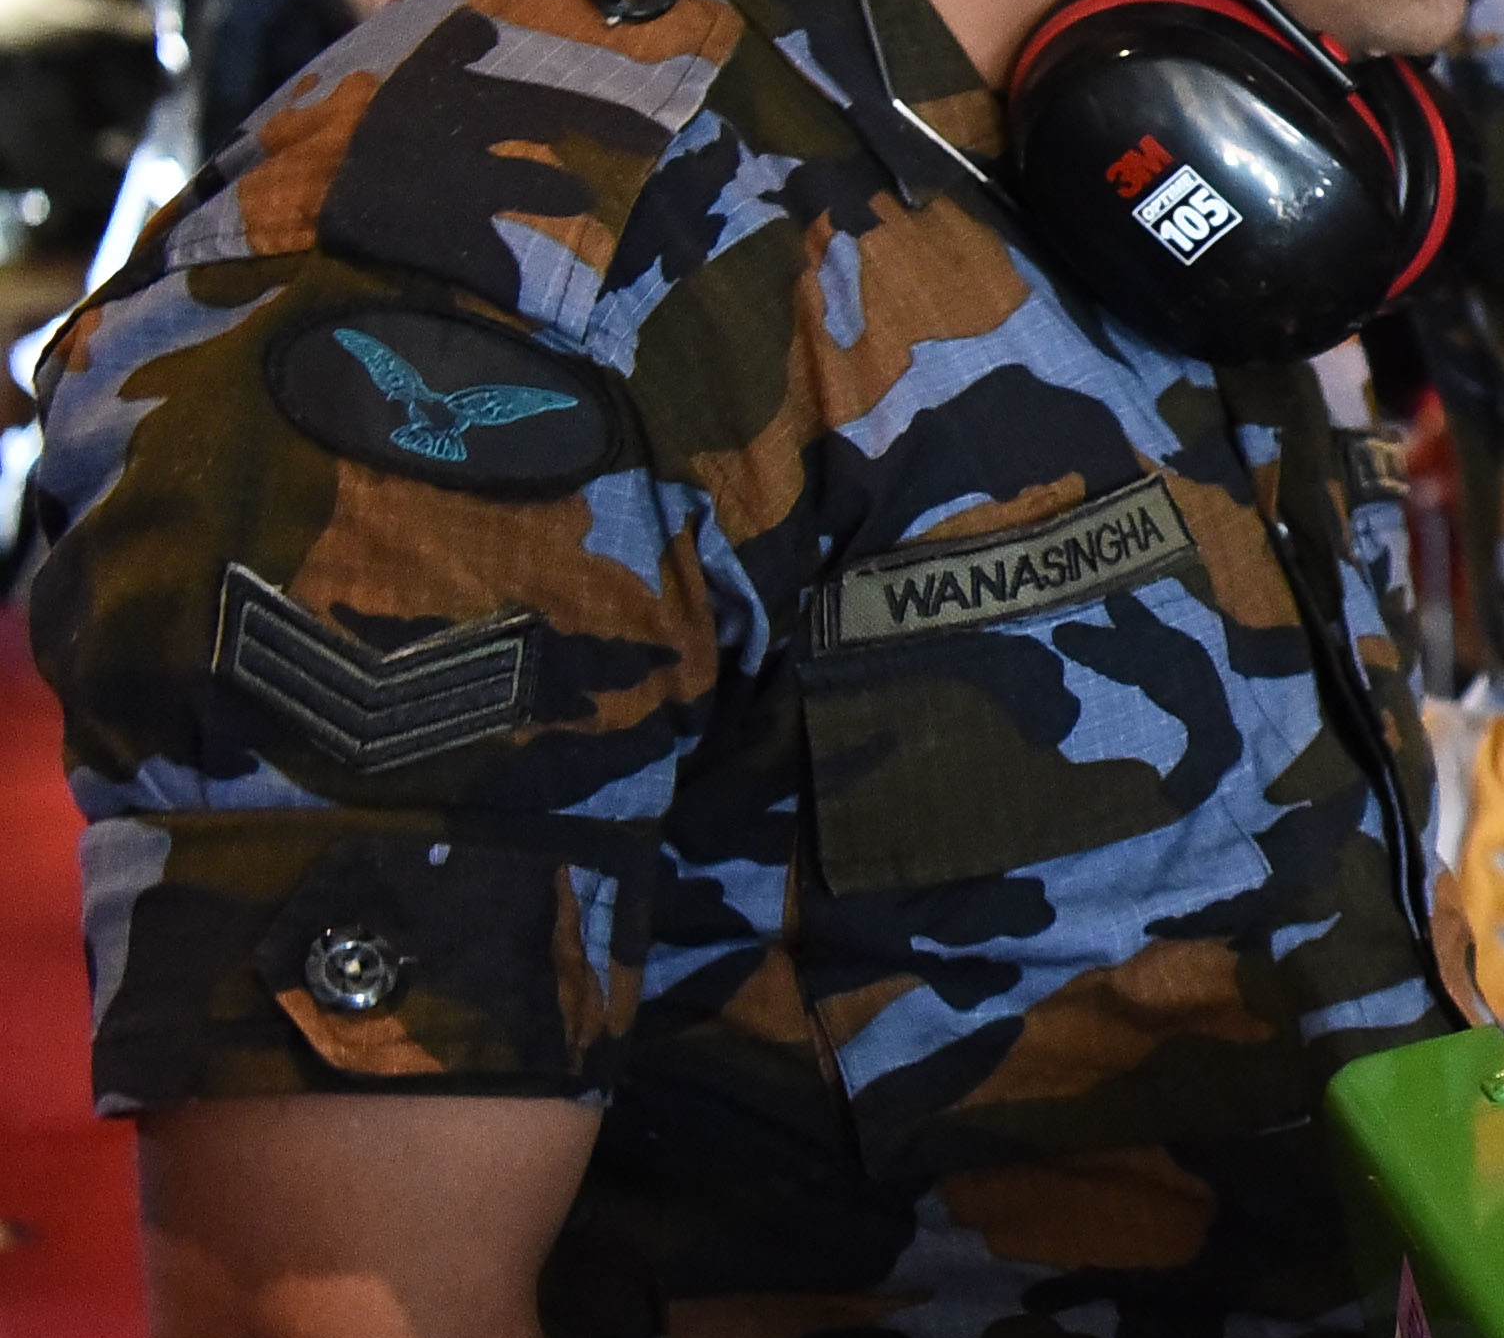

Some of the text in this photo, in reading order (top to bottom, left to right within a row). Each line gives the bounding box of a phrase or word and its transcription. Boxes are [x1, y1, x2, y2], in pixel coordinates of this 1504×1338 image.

[1106, 134, 1174, 198] 3M
[1160, 187, 1230, 252] 105
[884, 507, 1165, 623] WANASINGHA
